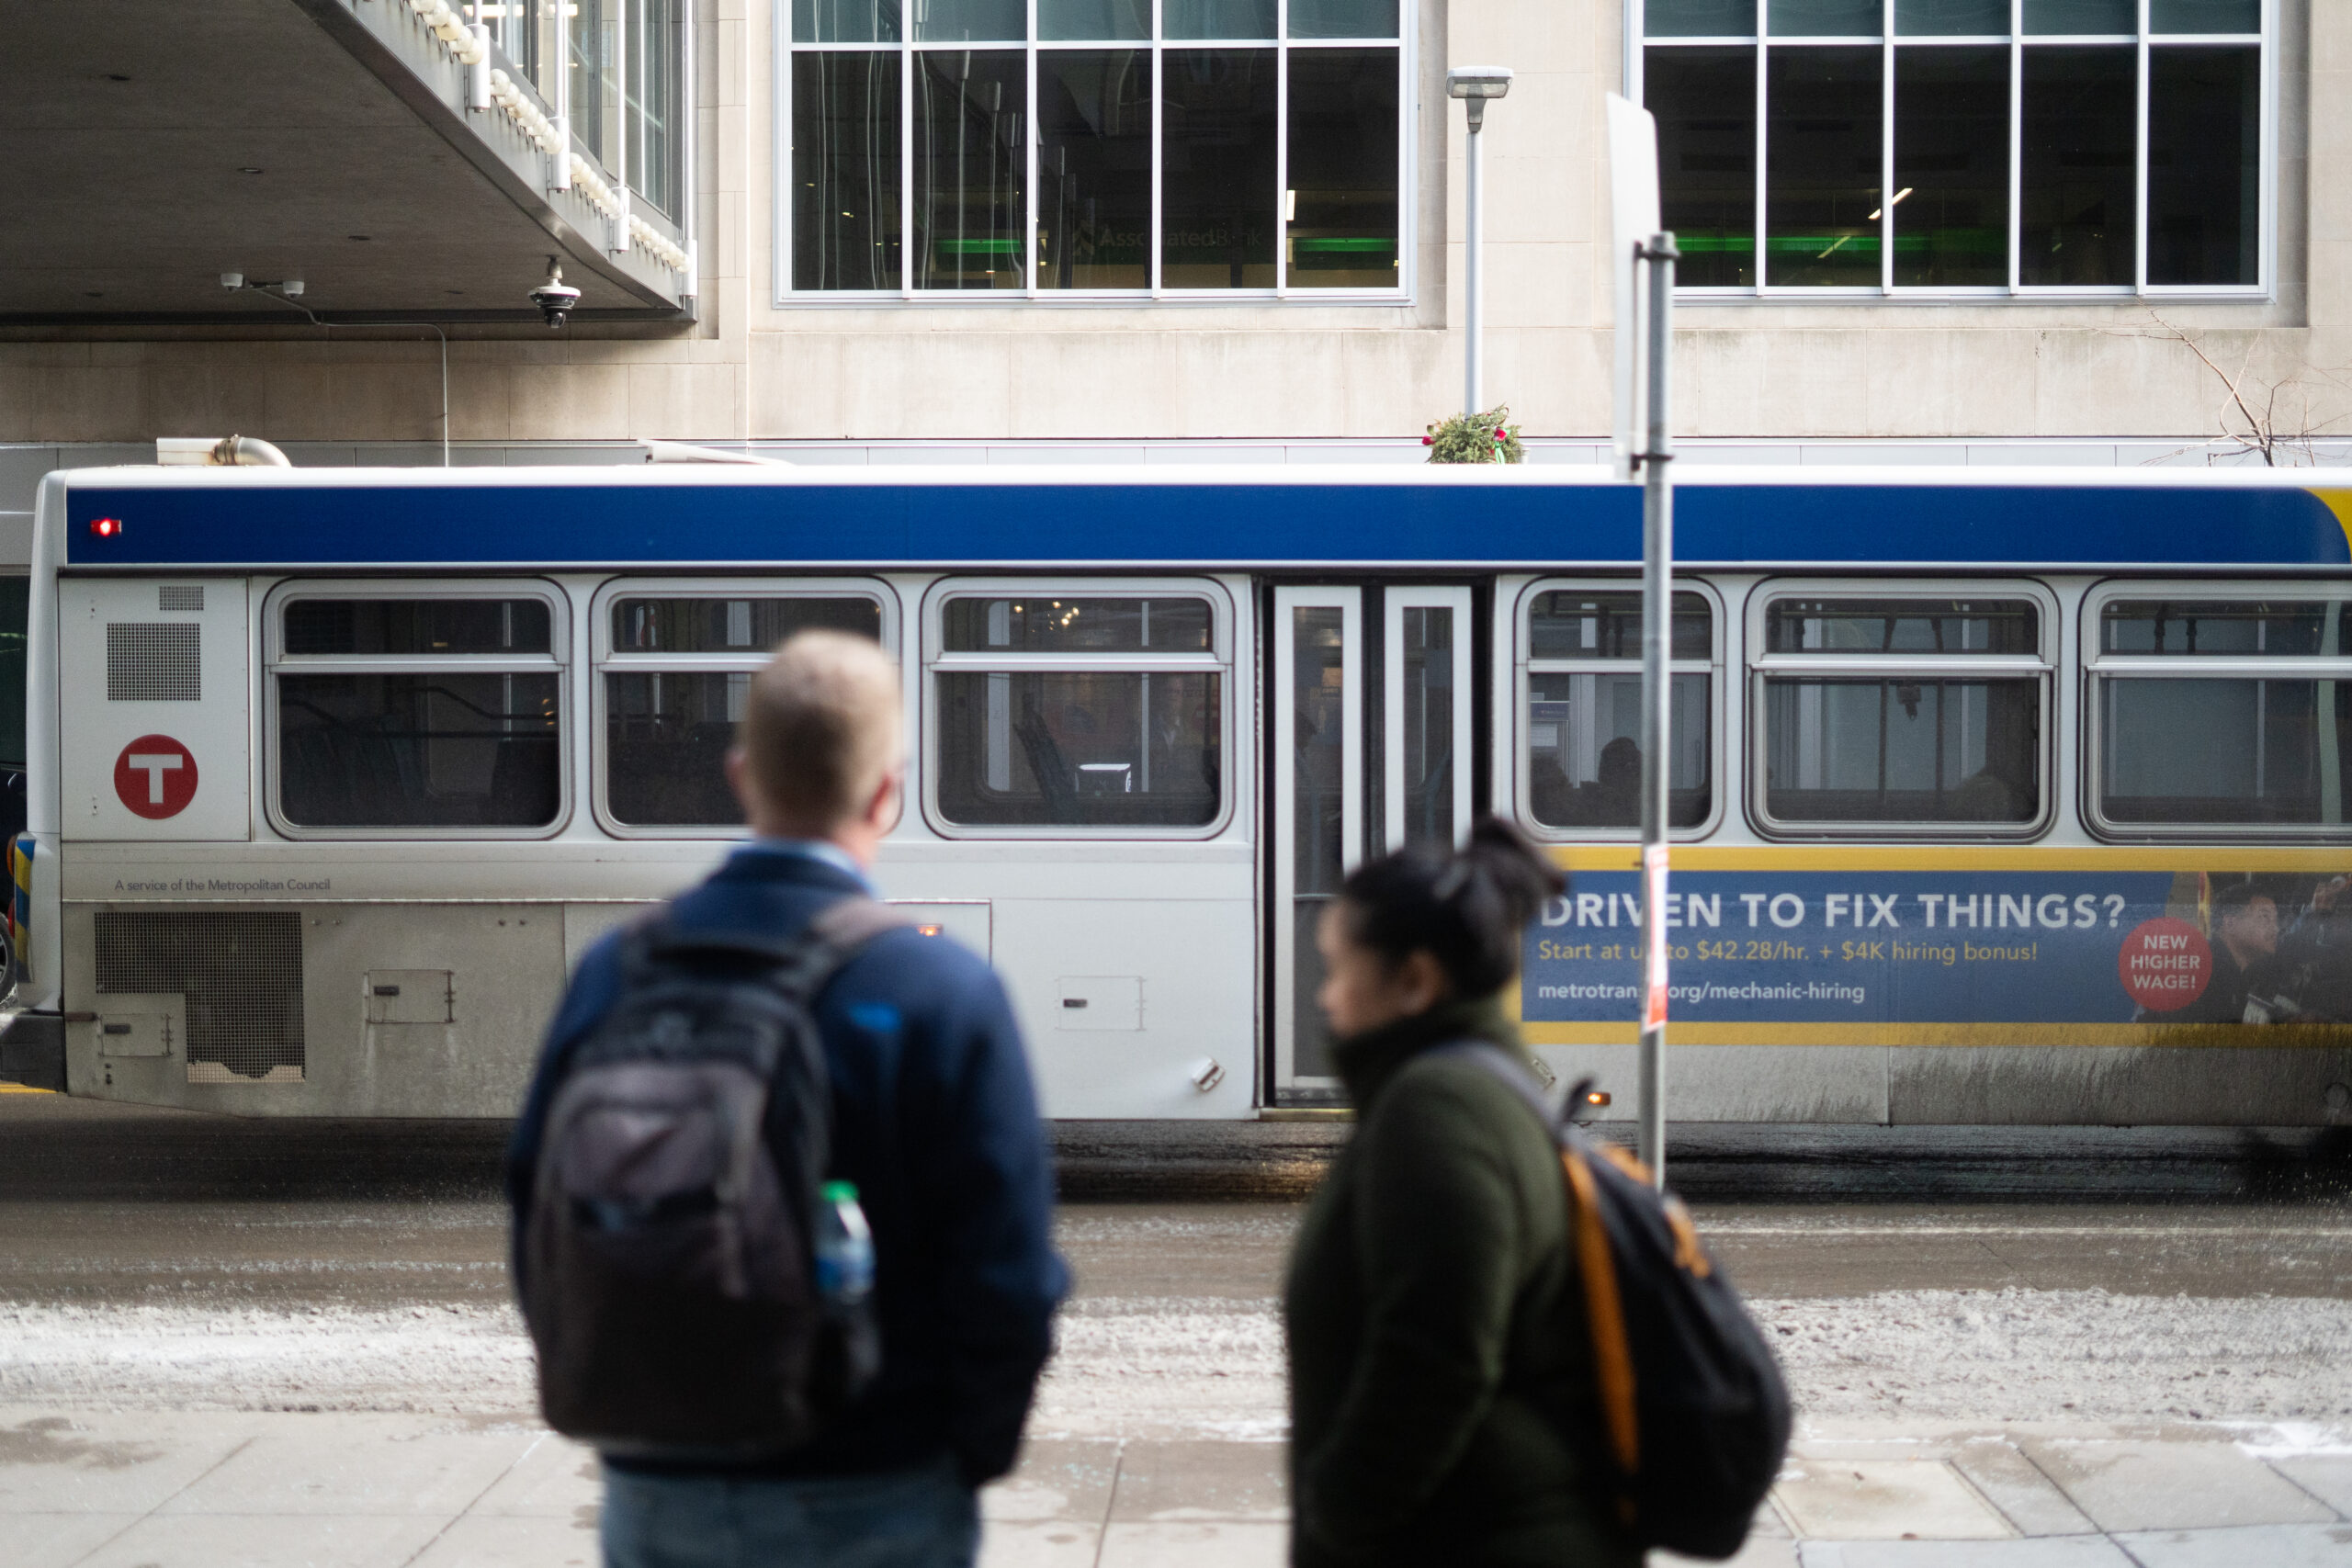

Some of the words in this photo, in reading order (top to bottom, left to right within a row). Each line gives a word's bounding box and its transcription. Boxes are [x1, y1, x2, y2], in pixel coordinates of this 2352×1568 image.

[129, 753, 183, 804] T
[115, 879, 124, 890] A
[127, 879, 167, 890] service
[170, 879, 184, 890] of
[186, 879, 205, 890] the
[208, 878, 284, 894] Metropolitan
[287, 878, 331, 890] Council
[1739, 893, 1805, 928] TO
[1825, 893, 1901, 928] FIX
[1917, 894, 2126, 929] THINGS?
[2143, 934, 2188, 950] NEW
[1539, 940, 1593, 960] Start
[1600, 943, 1622, 960] at
[1666, 944, 1690, 960] to
[1696, 939, 1810, 961] $42.28/hr.
[1819, 945, 1833, 958] +
[1841, 940, 1885, 962] $4K
[1892, 941, 1956, 965] hiring
[1963, 942, 2038, 961] bonus!
[2131, 954, 2201, 969] HIGHER
[2132, 974, 2197, 989] WAGE!
